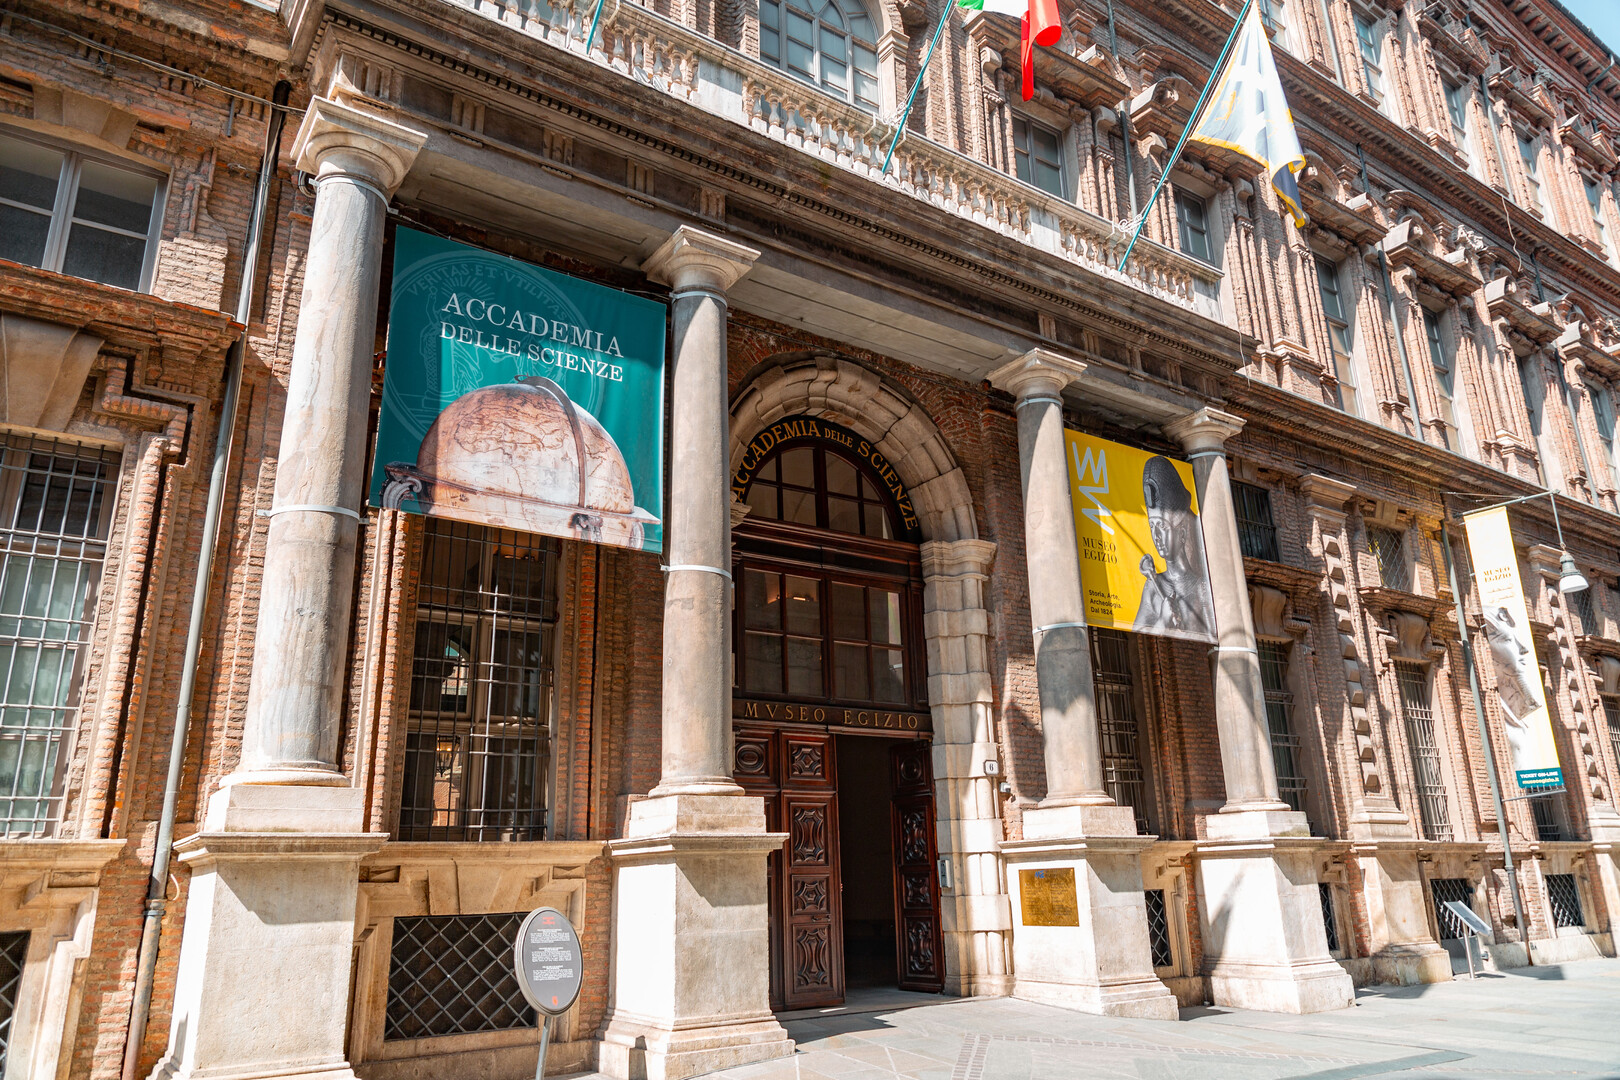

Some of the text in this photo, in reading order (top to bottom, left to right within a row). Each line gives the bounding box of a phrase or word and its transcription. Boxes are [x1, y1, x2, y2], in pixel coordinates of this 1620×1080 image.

[441, 292, 625, 358] ACCADEMIA
[439, 321, 624, 382] DELLE SCIENZE
[731, 420, 919, 531] ACCADEMIA DELLE SCIENZE
[1082, 536, 1117, 553] MUSEO
[1084, 548, 1118, 565] EGIZIO
[1088, 589, 1106, 599] Storia,
[1090, 606, 1100, 614] Dal
[744, 702, 919, 729] MVSEO EGIZIO
[989, 763, 994, 772] 6
